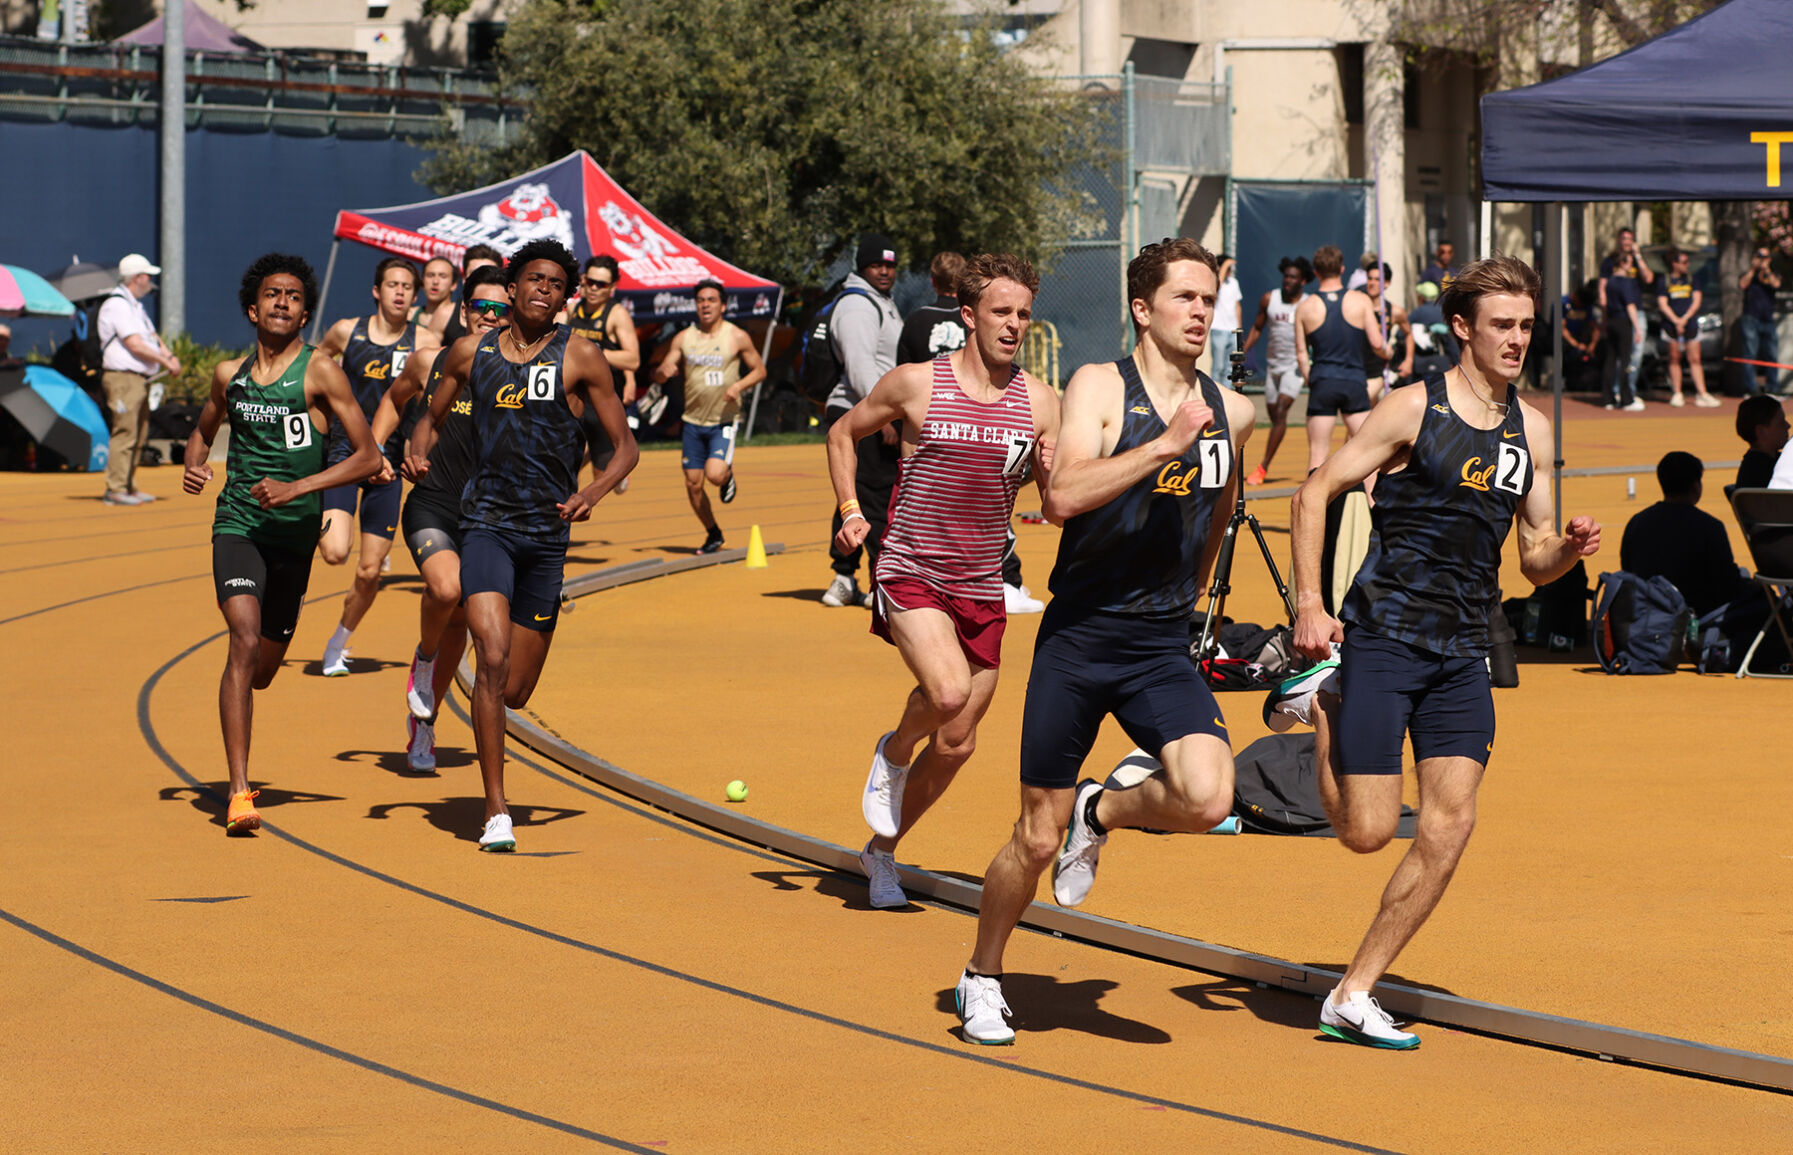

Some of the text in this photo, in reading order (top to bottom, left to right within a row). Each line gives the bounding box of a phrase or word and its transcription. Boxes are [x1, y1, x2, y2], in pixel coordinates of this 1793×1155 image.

[1750, 131, 1793, 187] T
[364, 360, 390, 380] Cal
[534, 367, 549, 398] 6
[708, 373, 719, 385] 11
[235, 401, 290, 415] PORTLAND
[495, 383, 527, 410] Cal
[243, 412, 277, 424] STATE
[289, 416, 305, 446] 9
[930, 422, 979, 442] SANTA
[1008, 440, 1028, 473] 7
[1208, 443, 1220, 485] 1
[1501, 448, 1520, 490] 2
[1152, 461, 1199, 496] Cal
[1459, 456, 1496, 492] Cal
